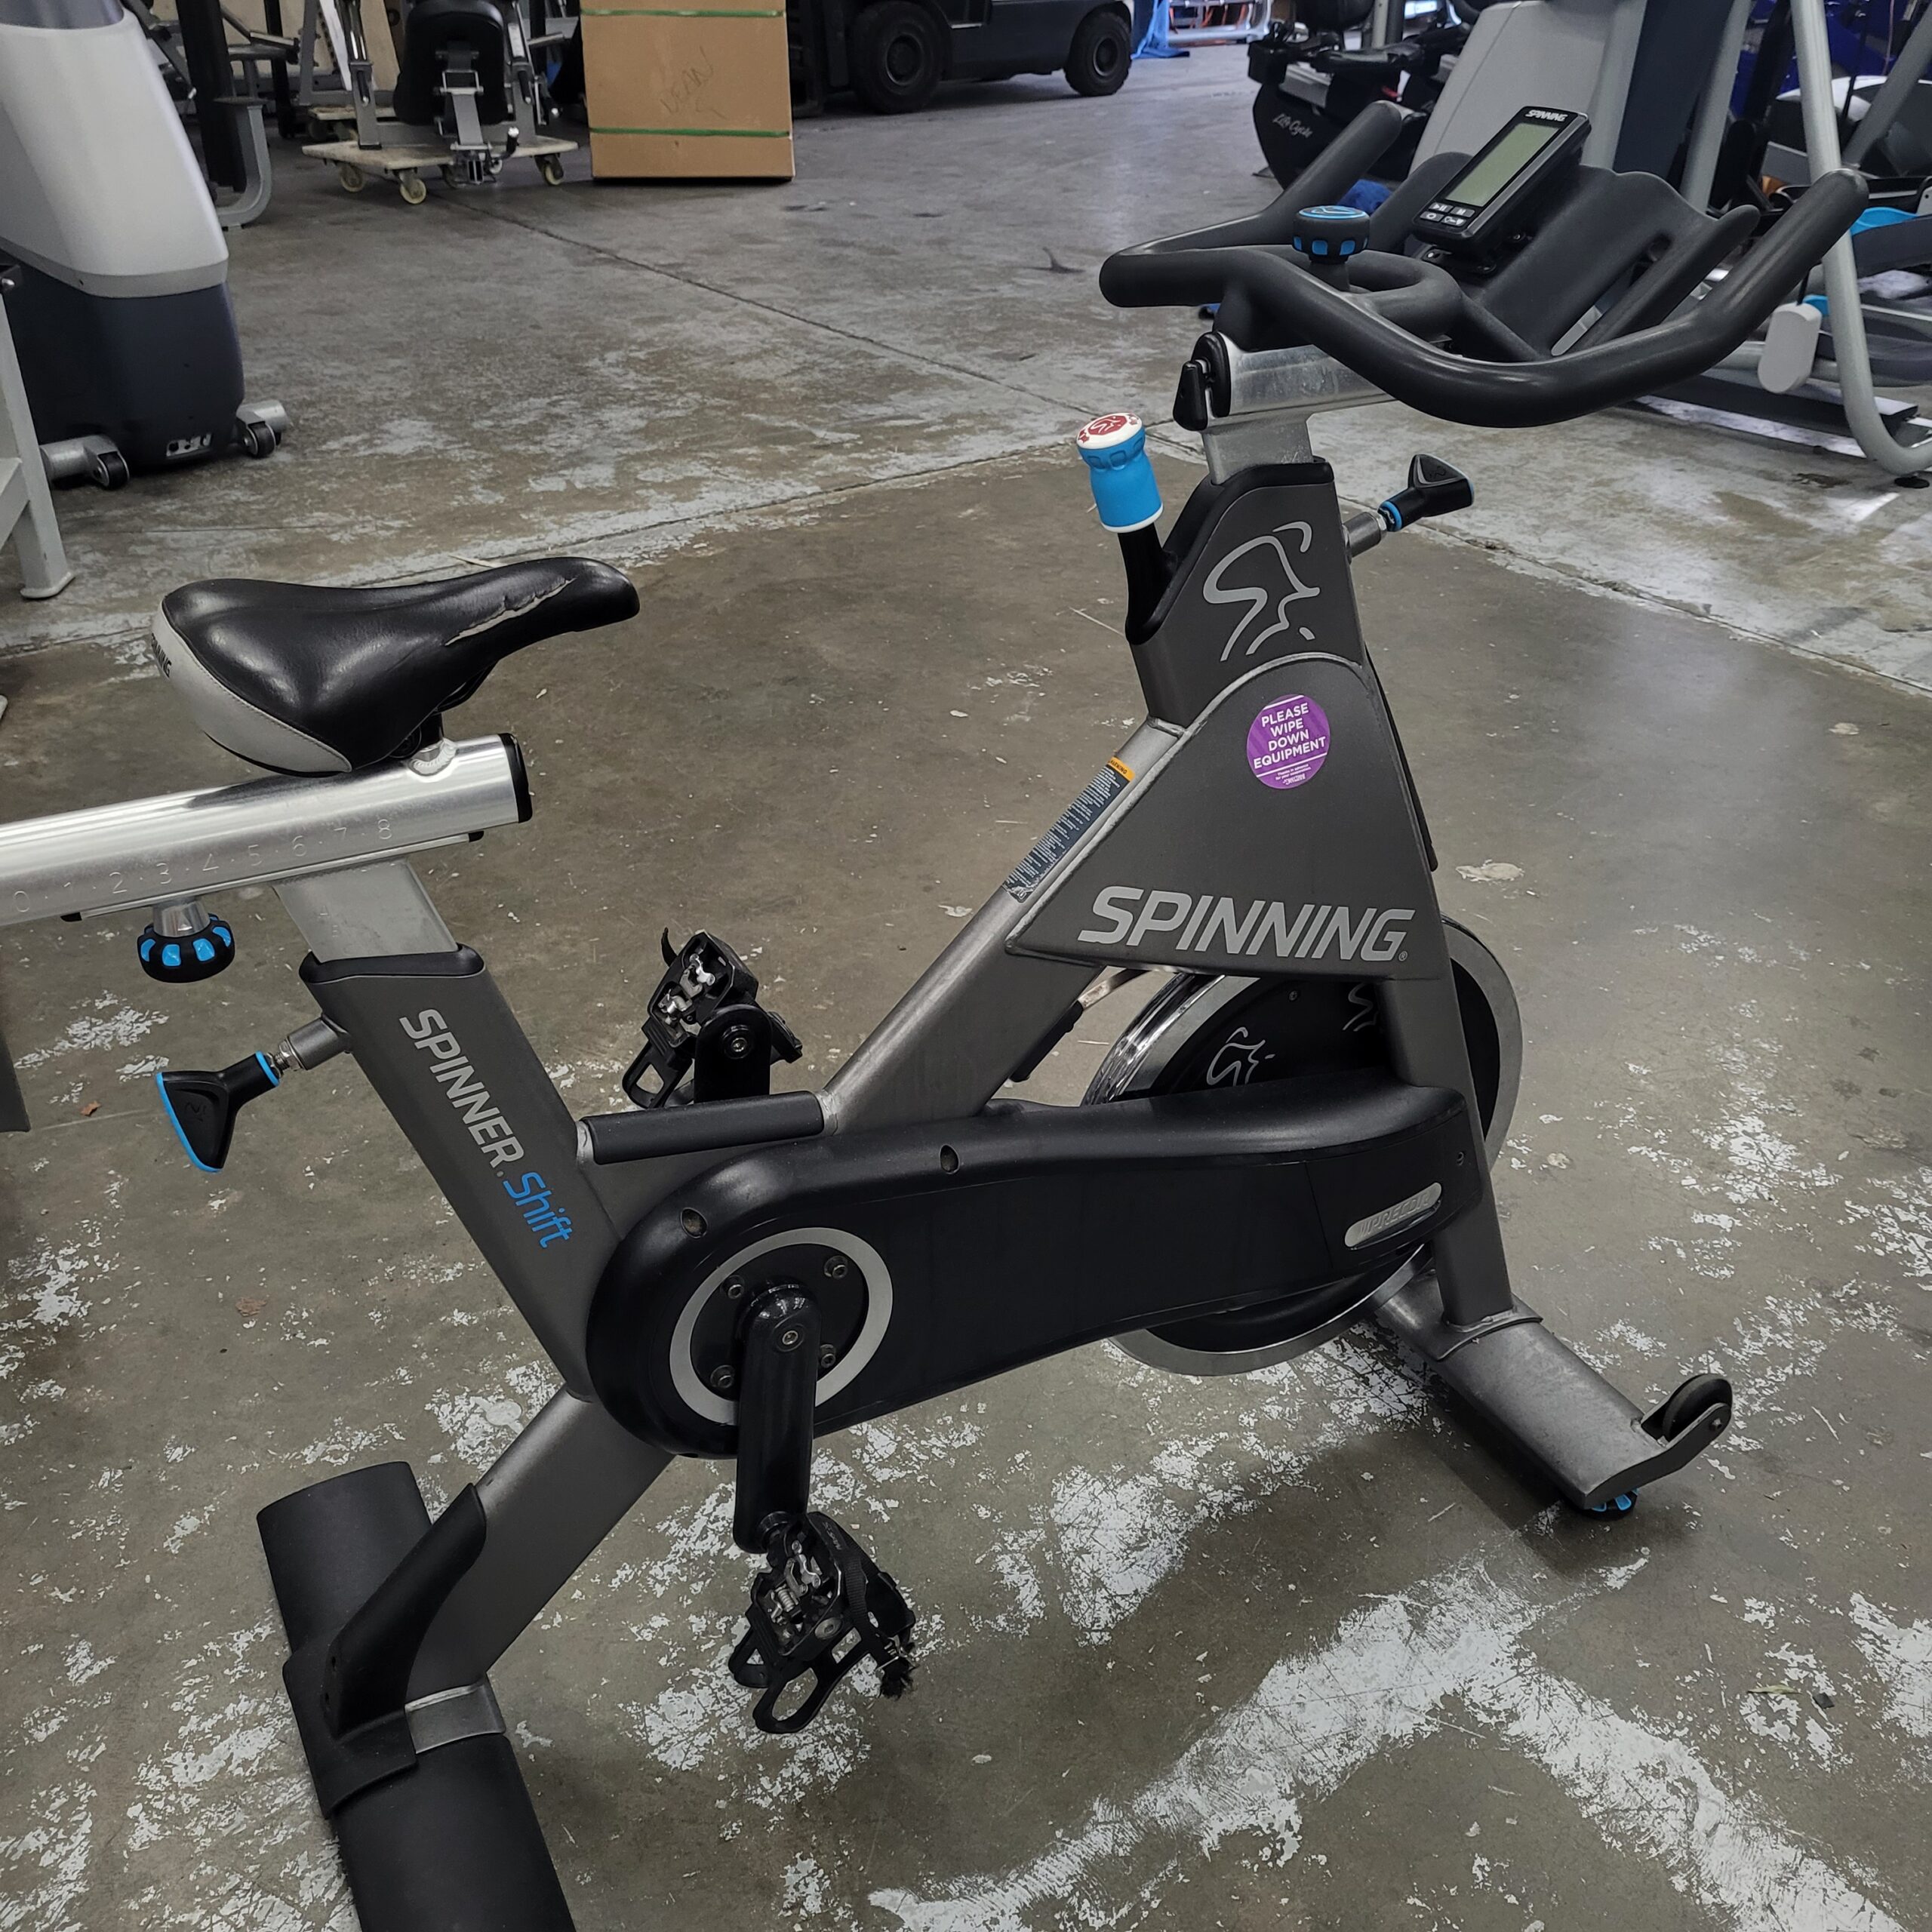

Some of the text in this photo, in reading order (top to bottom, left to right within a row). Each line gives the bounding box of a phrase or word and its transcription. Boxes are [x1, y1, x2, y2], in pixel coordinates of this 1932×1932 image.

[1525, 109, 1568, 122] SPINNING
[1261, 703, 1309, 728] PLEASE
[1270, 718, 1304, 737] WIPE
[1254, 736, 1326, 769] EQUIPMENT
[1268, 729, 1309, 752] DOWN
[109, 872, 128, 894] 2
[156, 863, 172, 884] 3
[202, 854, 220, 872] 4
[248, 844, 263, 866] 5
[292, 835, 307, 857] 6
[378, 819, 392, 840] 8
[1078, 886, 1416, 961] SPINNING
[399, 1008, 572, 1248] SPINNER Shift
